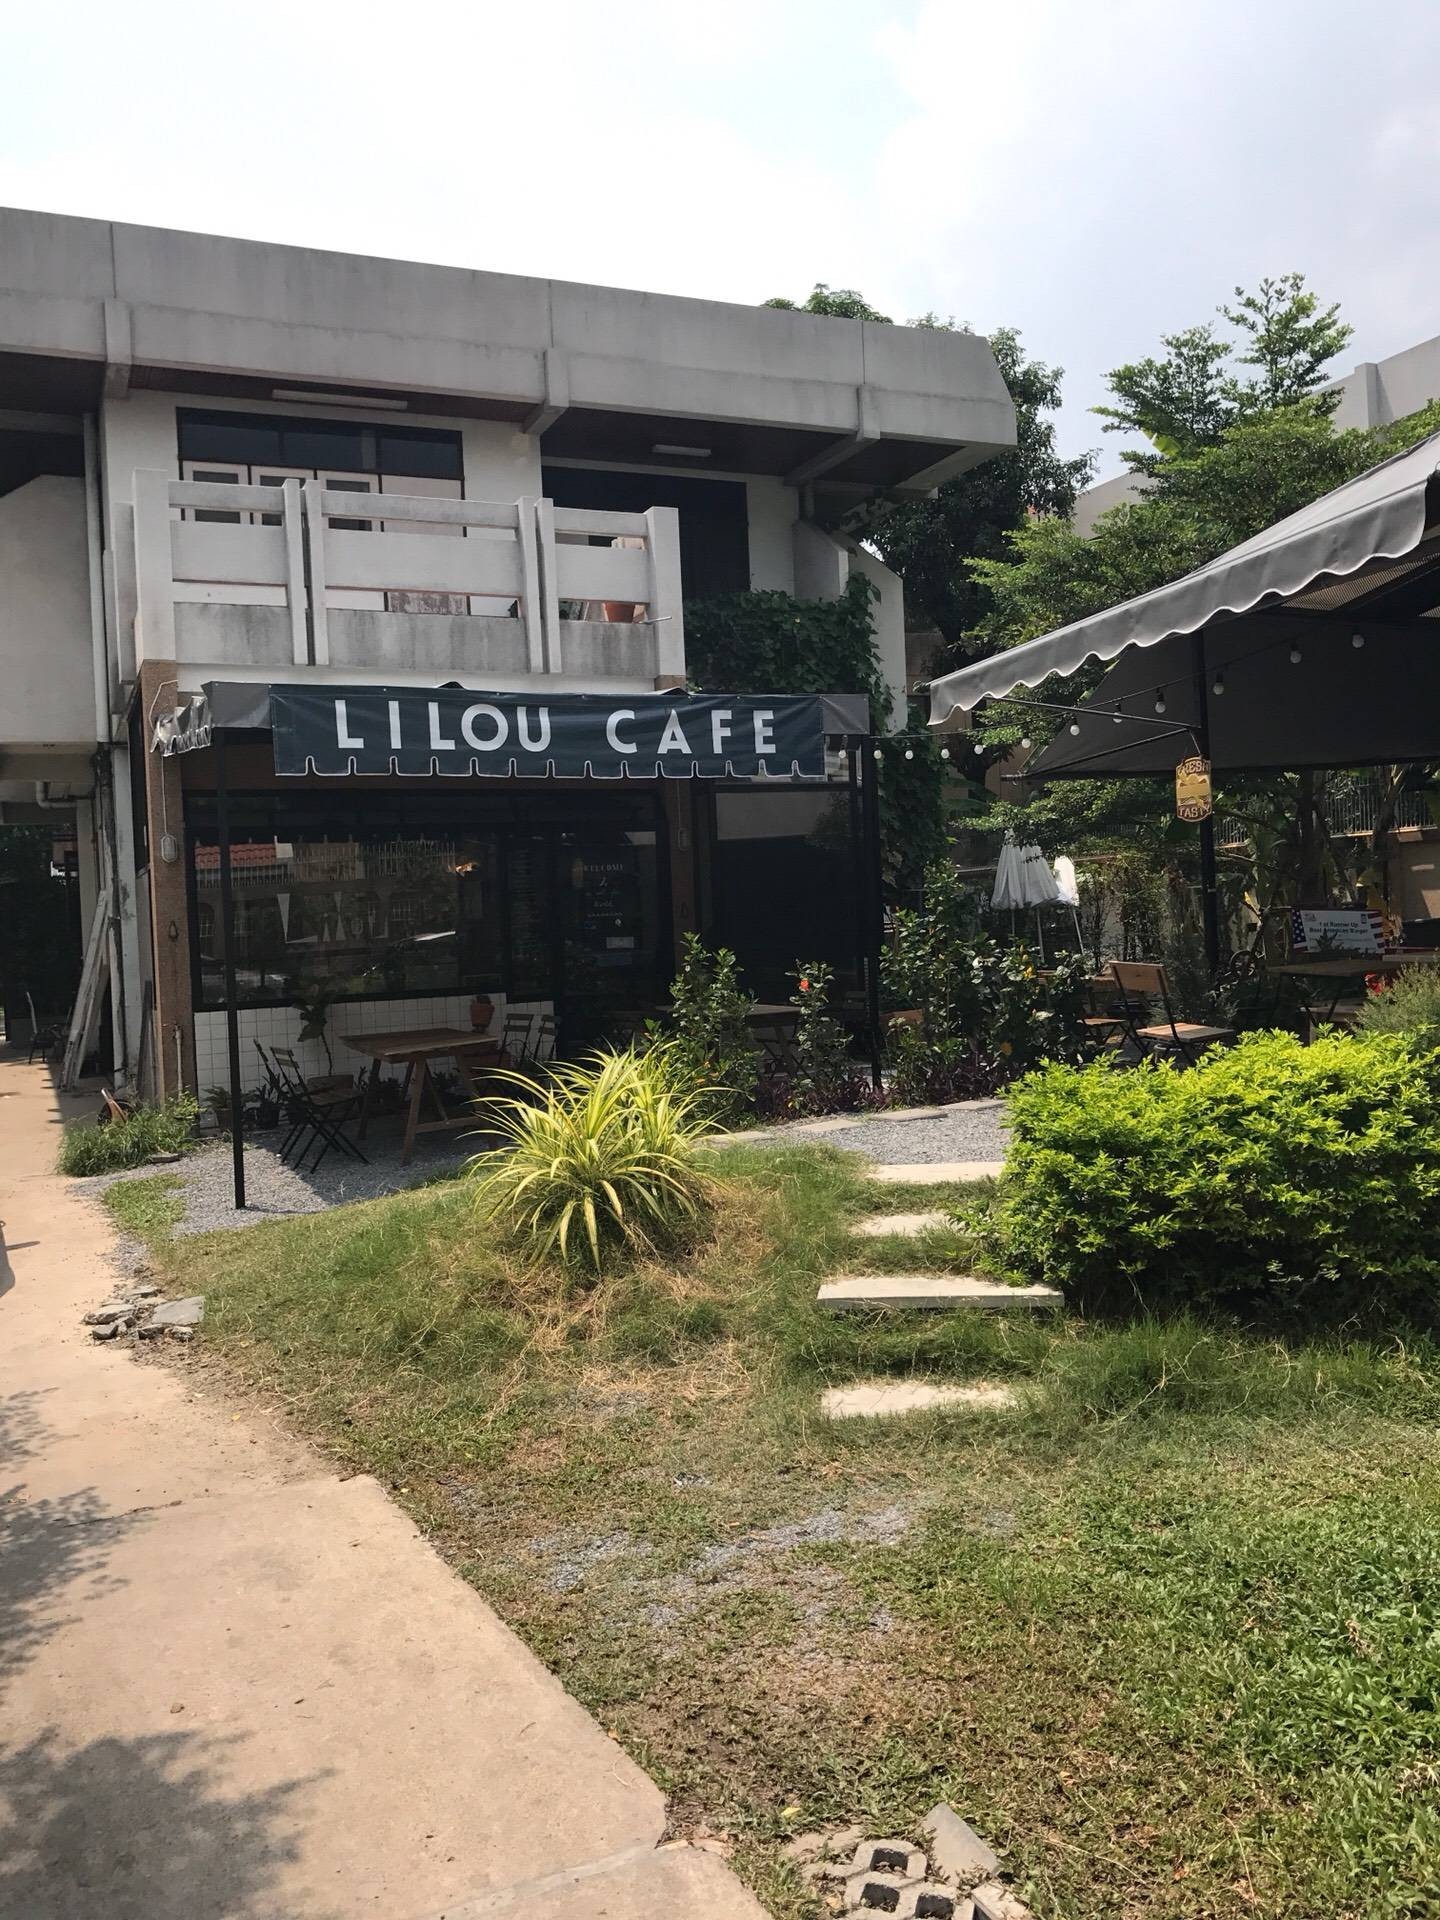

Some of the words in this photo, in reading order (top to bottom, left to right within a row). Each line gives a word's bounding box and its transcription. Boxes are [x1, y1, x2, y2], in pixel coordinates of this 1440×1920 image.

[335, 699, 551, 752] LILOU
[606, 709, 777, 754] CAFE
[1179, 760, 1210, 775] RESH
